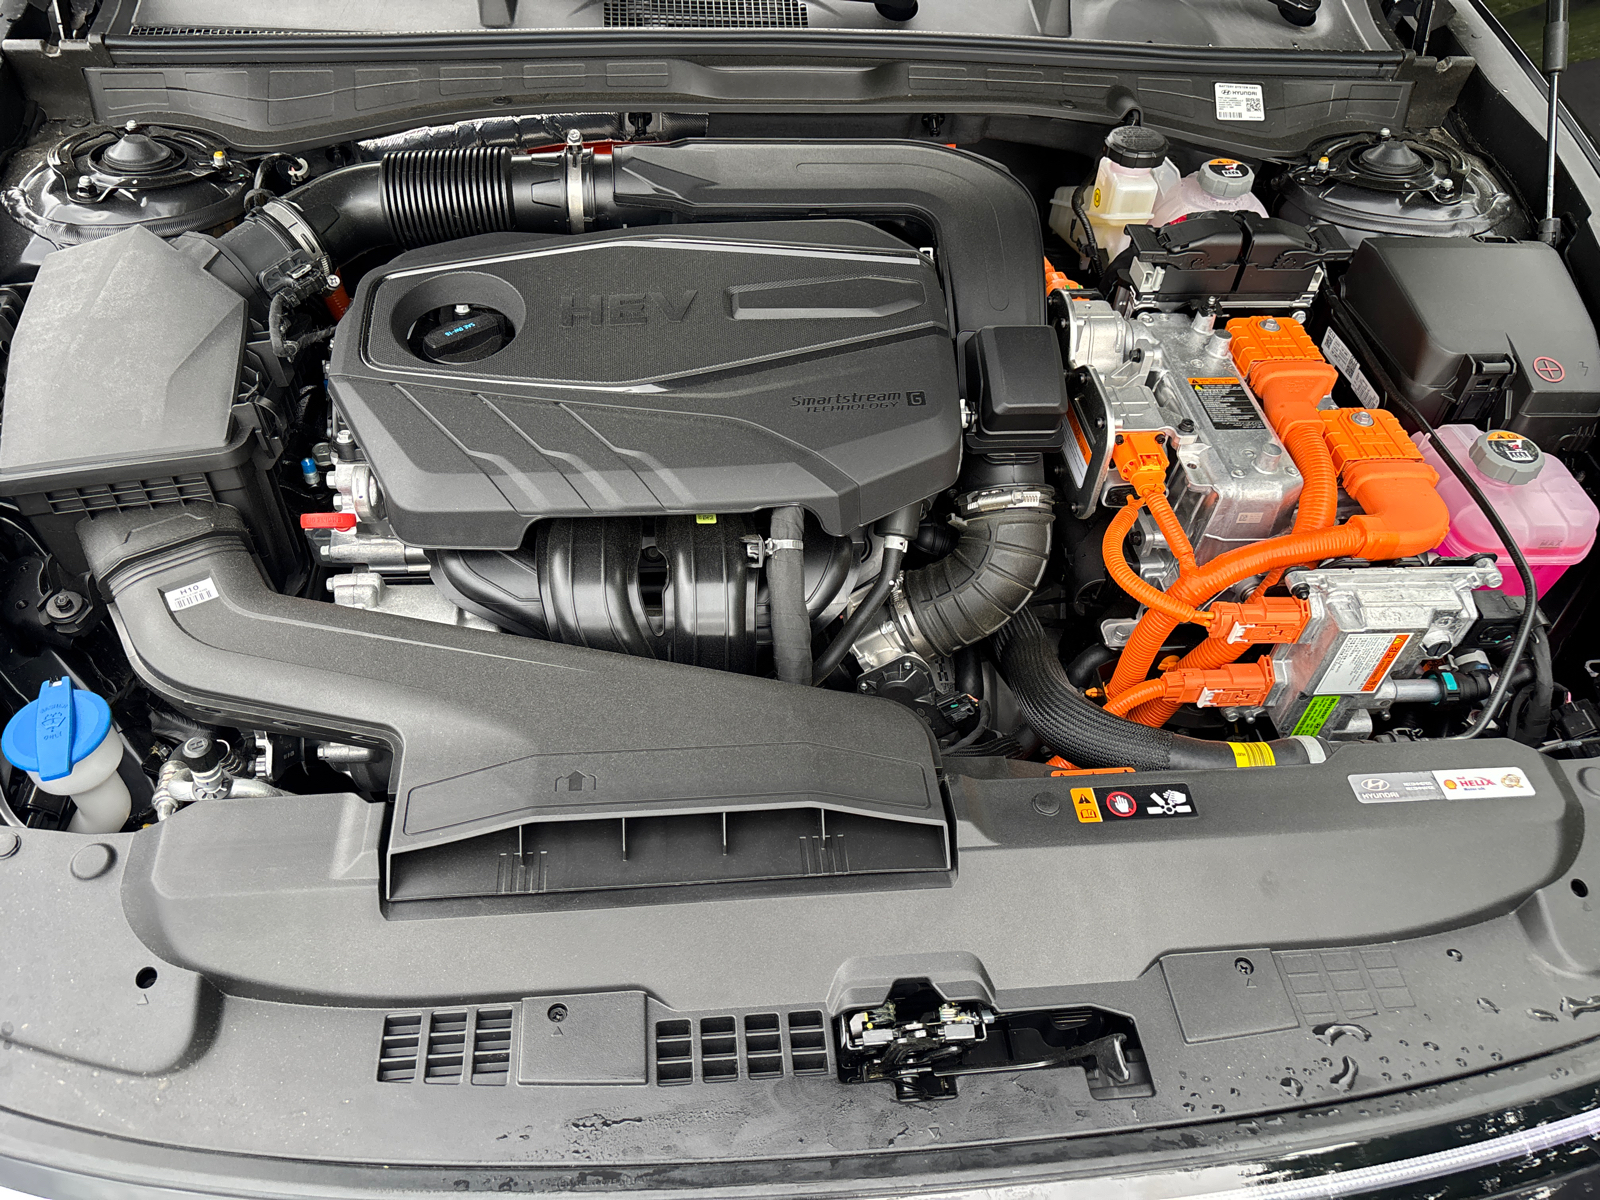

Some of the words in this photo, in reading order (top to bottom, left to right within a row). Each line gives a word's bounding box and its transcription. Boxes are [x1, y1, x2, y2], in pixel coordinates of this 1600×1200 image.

[560, 289, 698, 327] HEV
[790, 392, 901, 406] Smartstream
[908, 392, 924, 405] G
[806, 402, 899, 412] TECHNOLOGY
[180, 585, 199, 595] H10
[1459, 778, 1497, 787] HELIX
